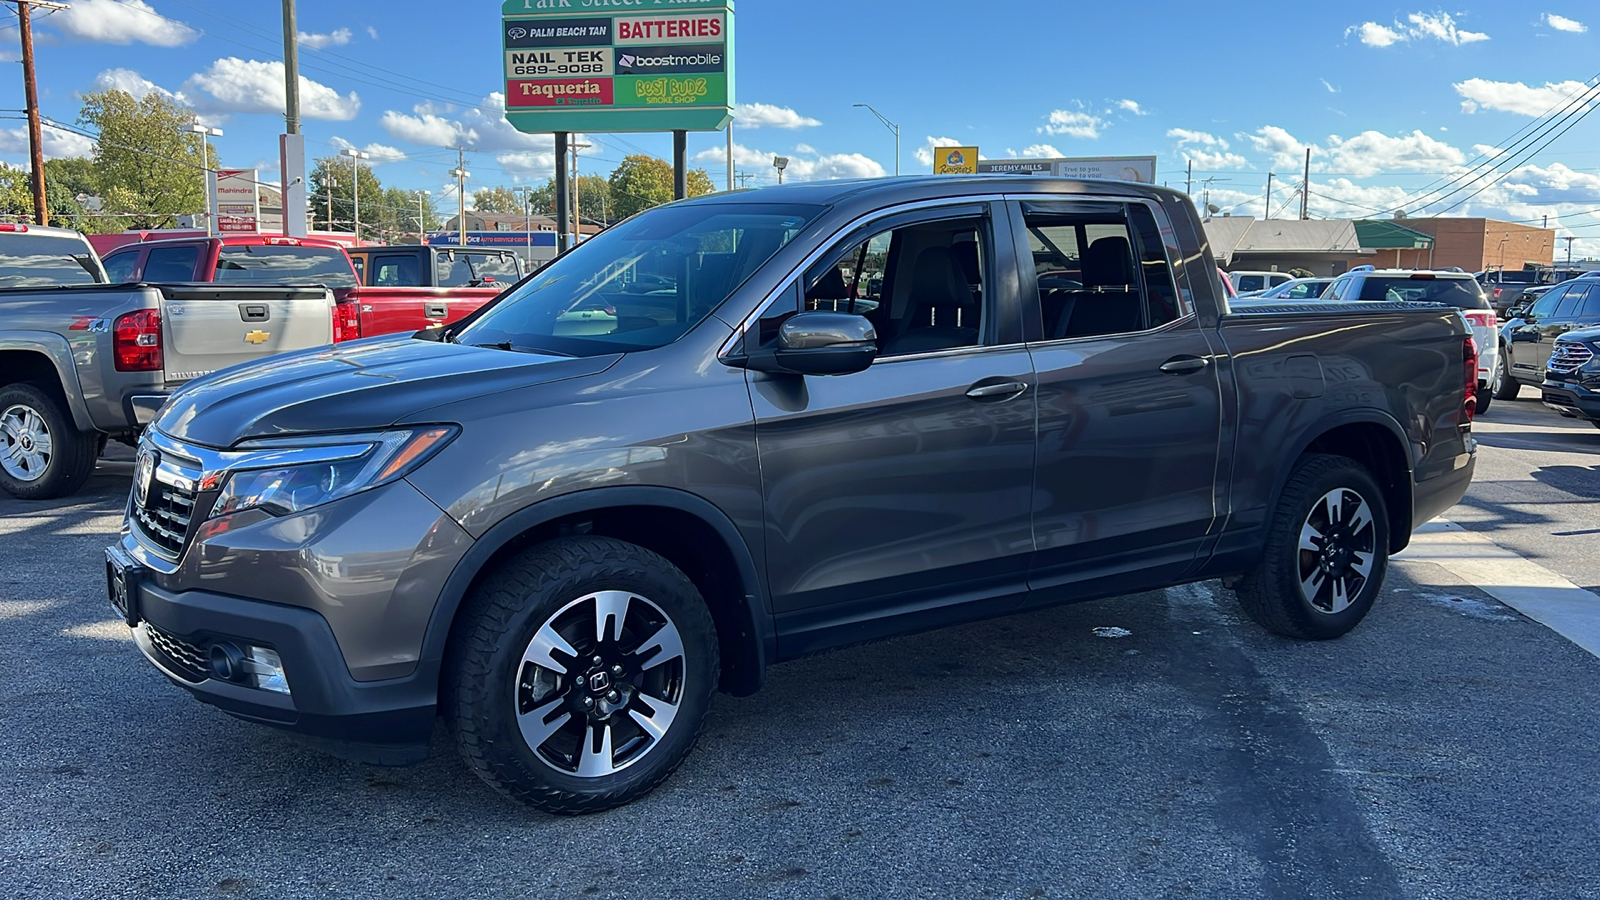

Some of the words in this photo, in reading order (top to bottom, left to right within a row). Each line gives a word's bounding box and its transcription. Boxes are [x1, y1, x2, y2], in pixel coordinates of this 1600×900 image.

[530, 28, 554, 37] PALM
[556, 27, 587, 37] BEACH
[589, 26, 606, 36] TAN
[619, 18, 720, 39] BATTERIES
[512, 53, 556, 64] NAIL
[564, 51, 604, 62] TEK
[515, 64, 603, 75] 689-9088
[674, 96, 696, 104] SHOP
[939, 164, 972, 174] Roosters
[990, 164, 1020, 172] JEREMY
[170, 370, 216, 379] SILVER
